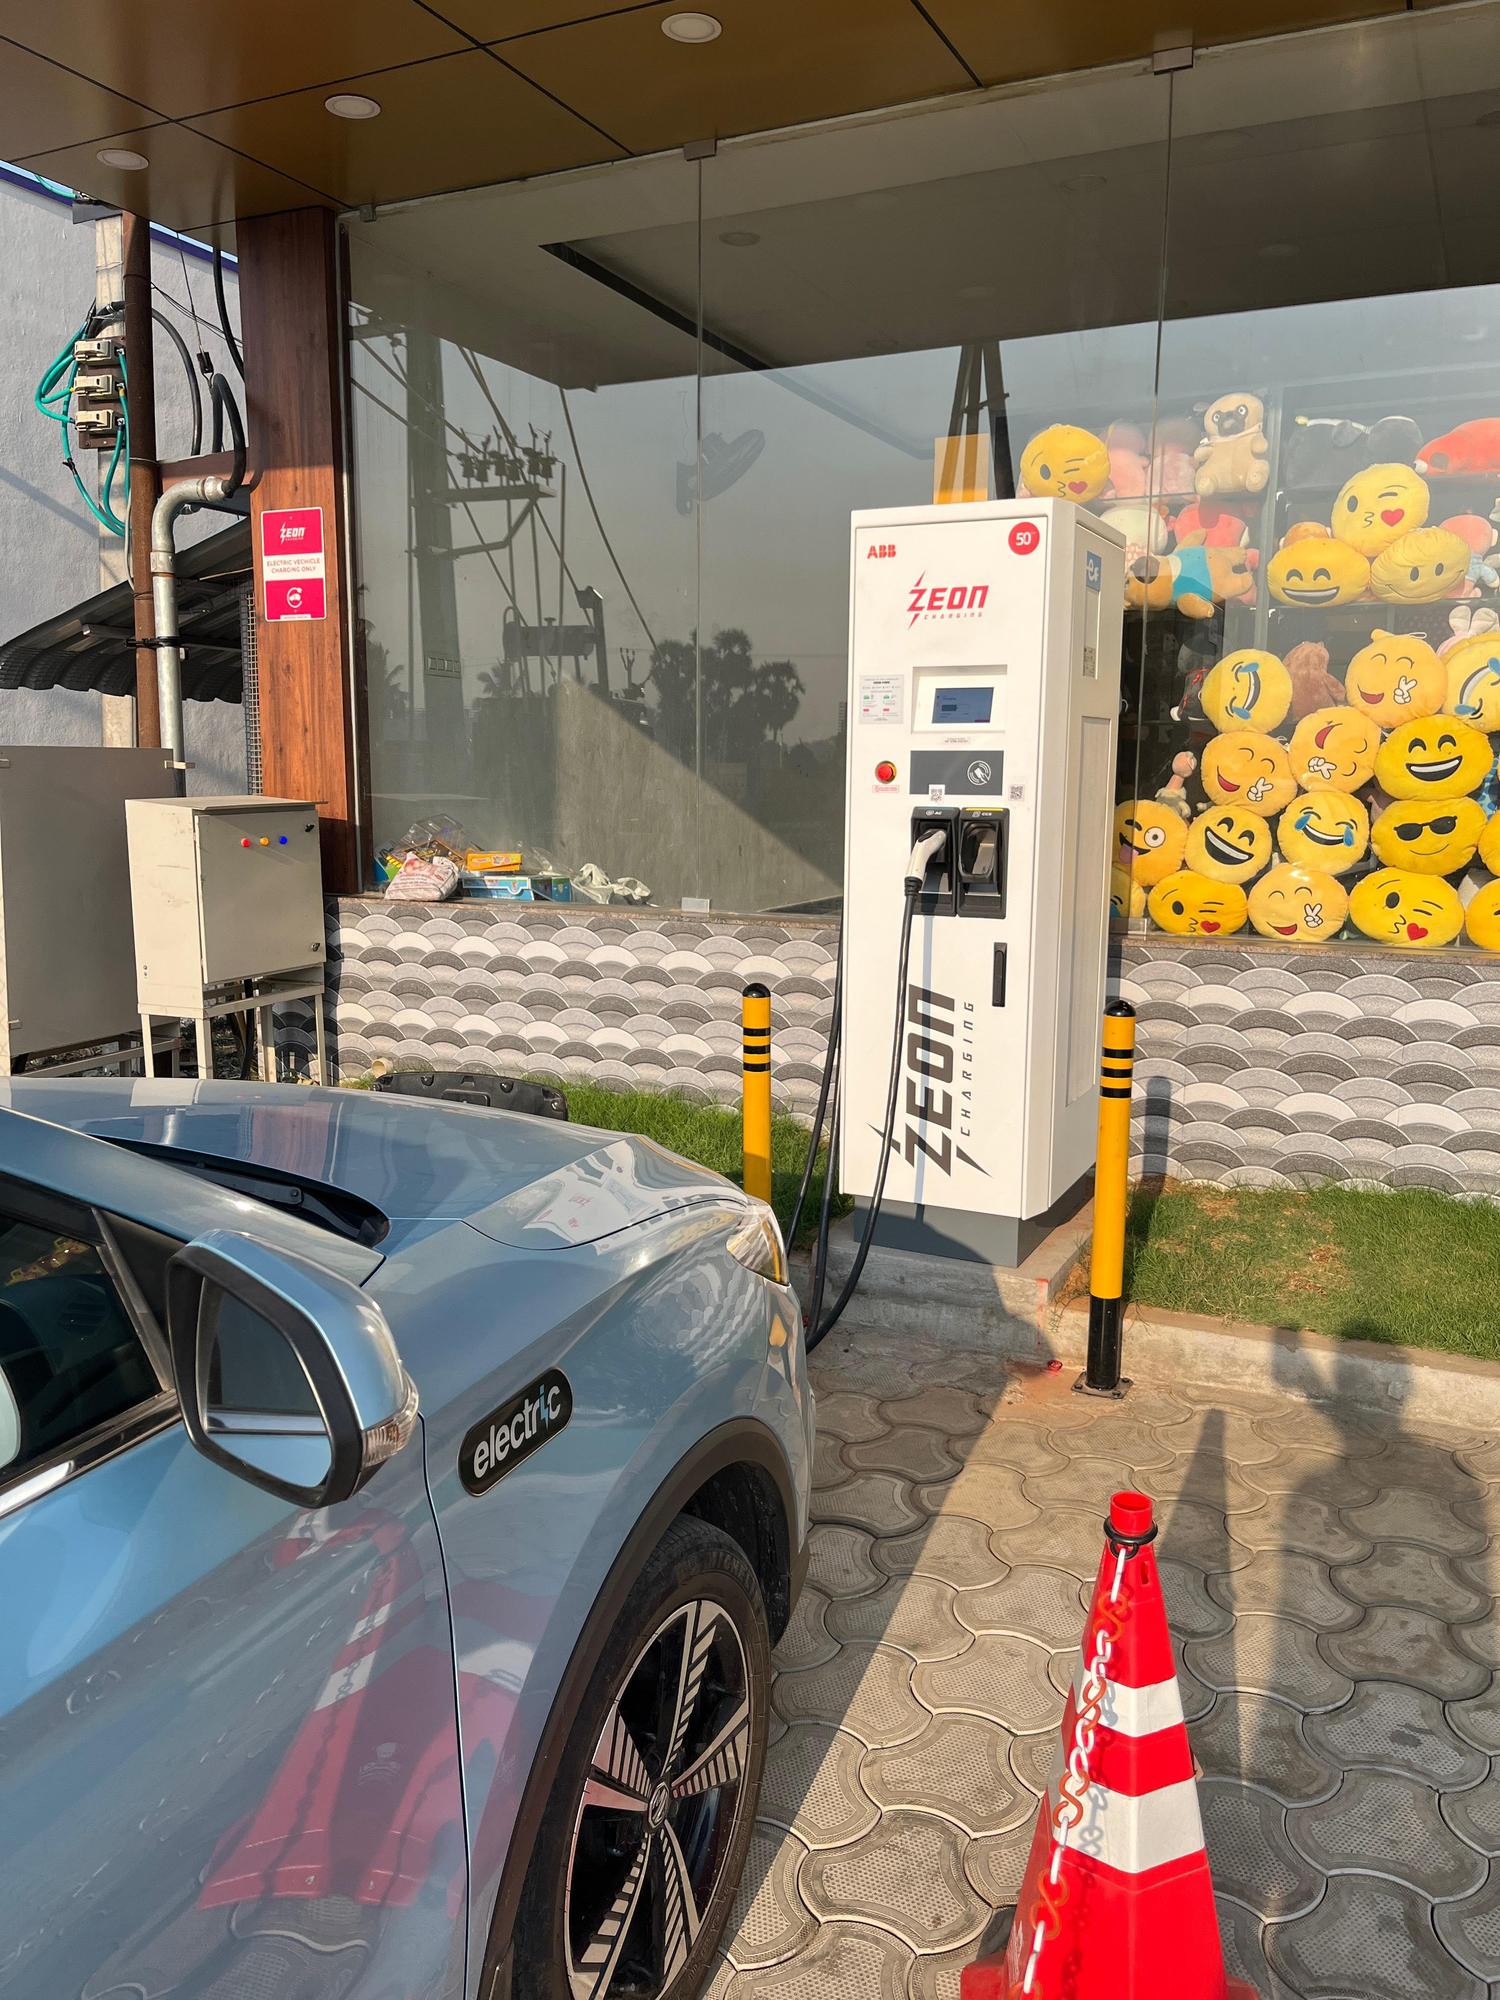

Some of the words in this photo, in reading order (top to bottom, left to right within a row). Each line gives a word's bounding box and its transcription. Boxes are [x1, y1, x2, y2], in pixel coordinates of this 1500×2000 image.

[1015, 532, 1032, 546] 50
[867, 544, 897, 559] ABB
[267, 559, 292, 567] ELECTRIC
[961, 1001, 974, 1137] CHARGING
[473, 1383, 562, 1479] electric
